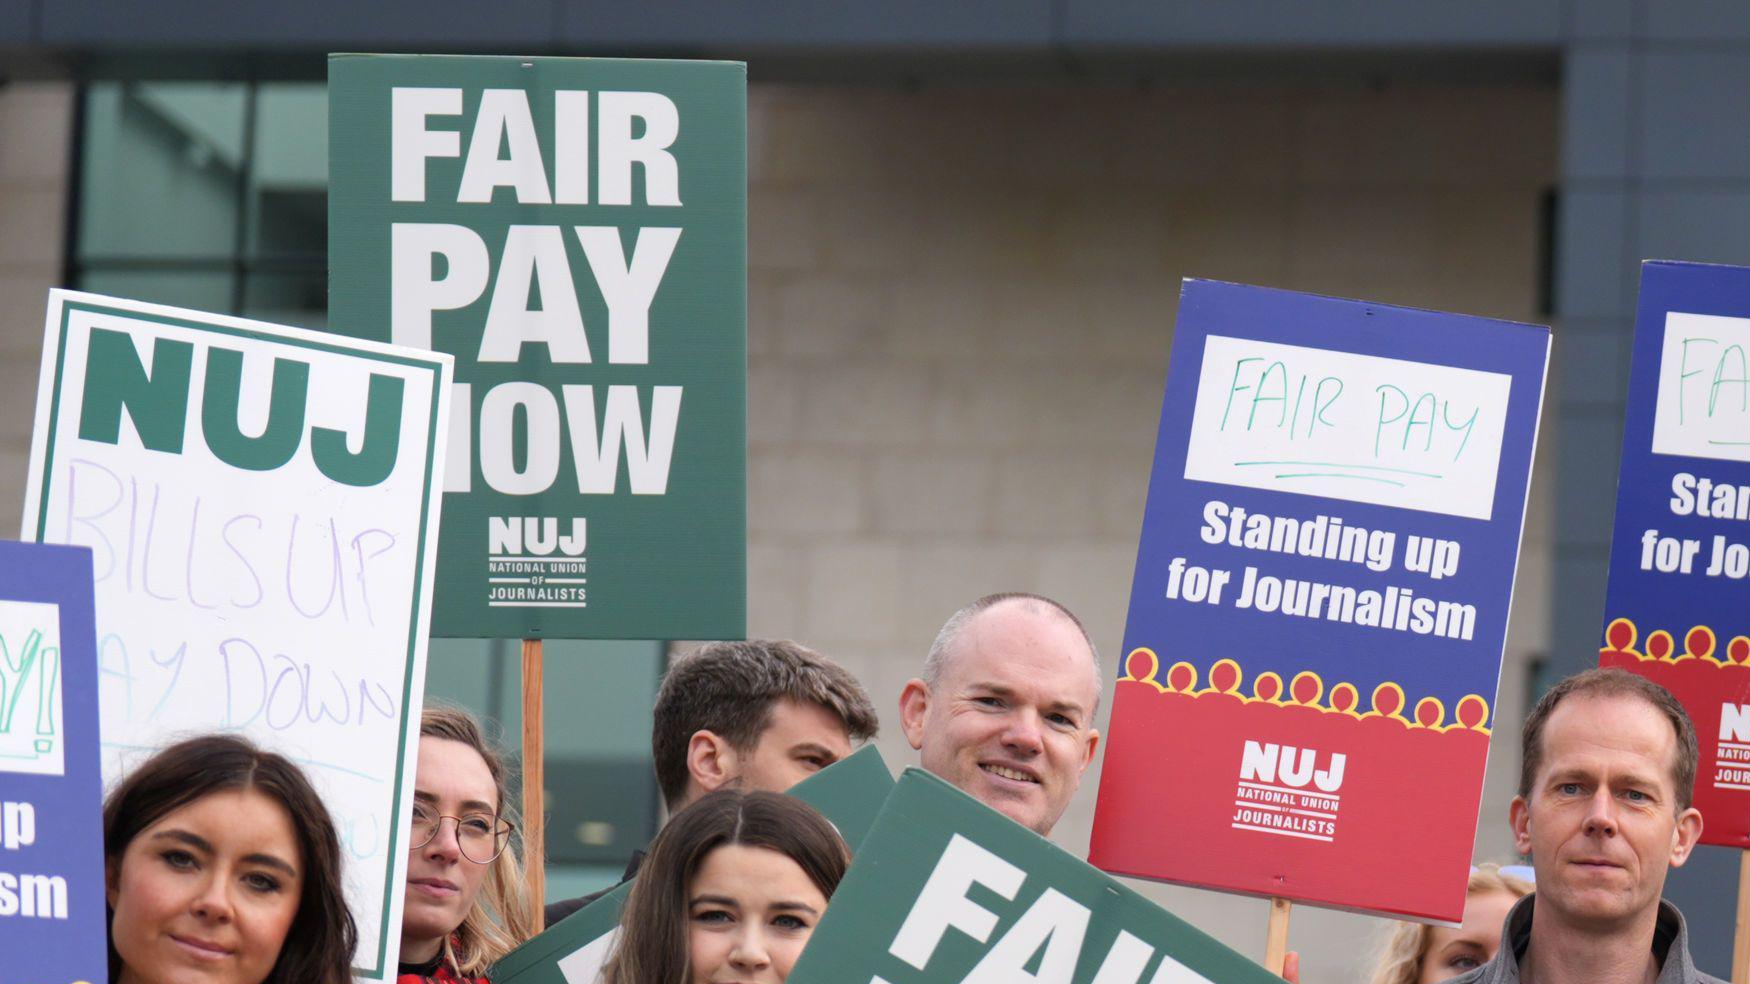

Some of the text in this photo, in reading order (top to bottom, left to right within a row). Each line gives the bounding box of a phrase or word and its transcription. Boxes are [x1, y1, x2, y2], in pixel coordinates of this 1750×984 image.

[392, 87, 683, 206] FAIR
[391, 222, 683, 364] PAY
[78, 327, 405, 487] NUJ
[441, 381, 683, 496] OW
[1219, 357, 1479, 463] FAIR PAY
[65, 458, 398, 627] BILLS UP
[489, 517, 586, 556] NUJ
[489, 562, 586, 573] NATIONAL UNION
[1200, 501, 1461, 579] Standing up
[1640, 529, 1701, 573] for
[489, 588, 586, 600] JOURNALISTS
[531, 576, 544, 585] OF
[1165, 558, 1477, 641] for Journalism
[99, 632, 396, 731] AY DOWN
[1237, 787, 1339, 811] NATIONAL UNION
[1240, 740, 1346, 792] NUJ
[1233, 809, 1335, 835] JOURNALISTS
